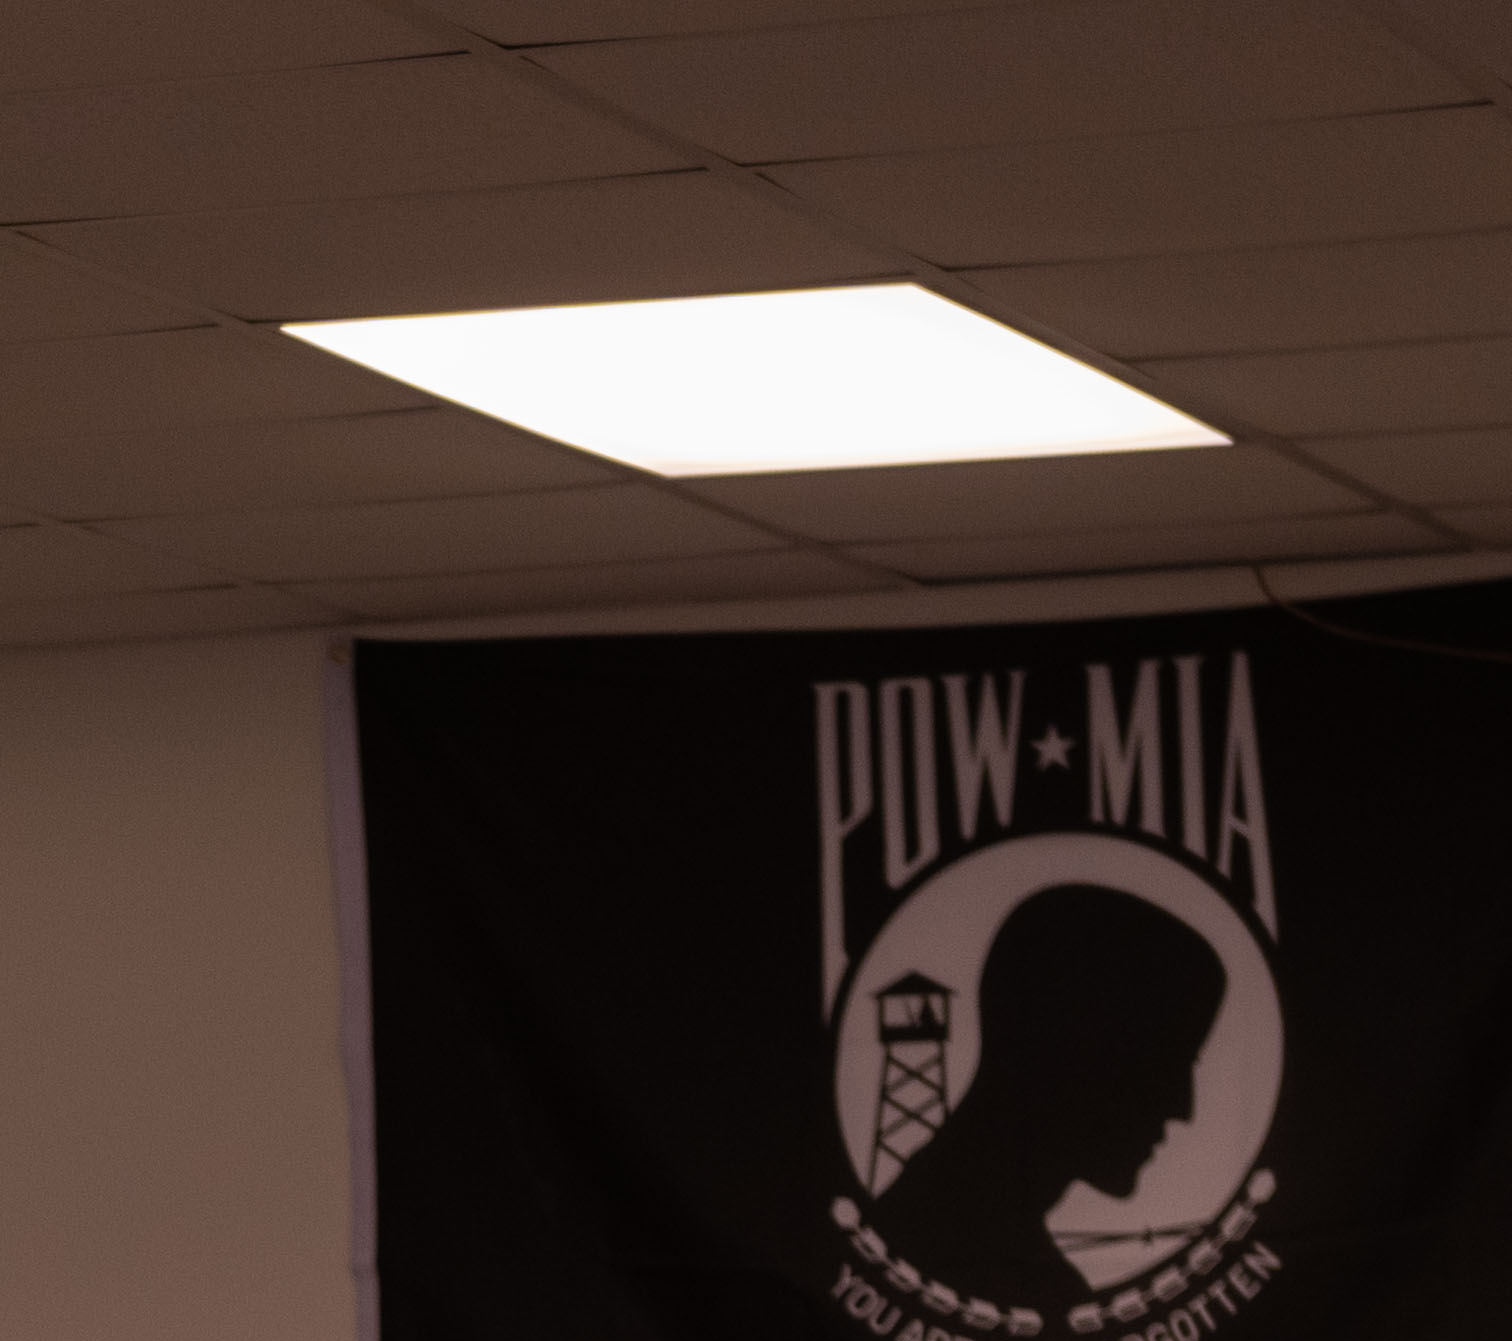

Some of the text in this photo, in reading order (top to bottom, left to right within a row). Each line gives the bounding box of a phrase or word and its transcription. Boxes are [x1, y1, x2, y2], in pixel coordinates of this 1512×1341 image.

[811, 649, 1278, 1028] POW MIA
[830, 1263, 902, 1336] YOU
